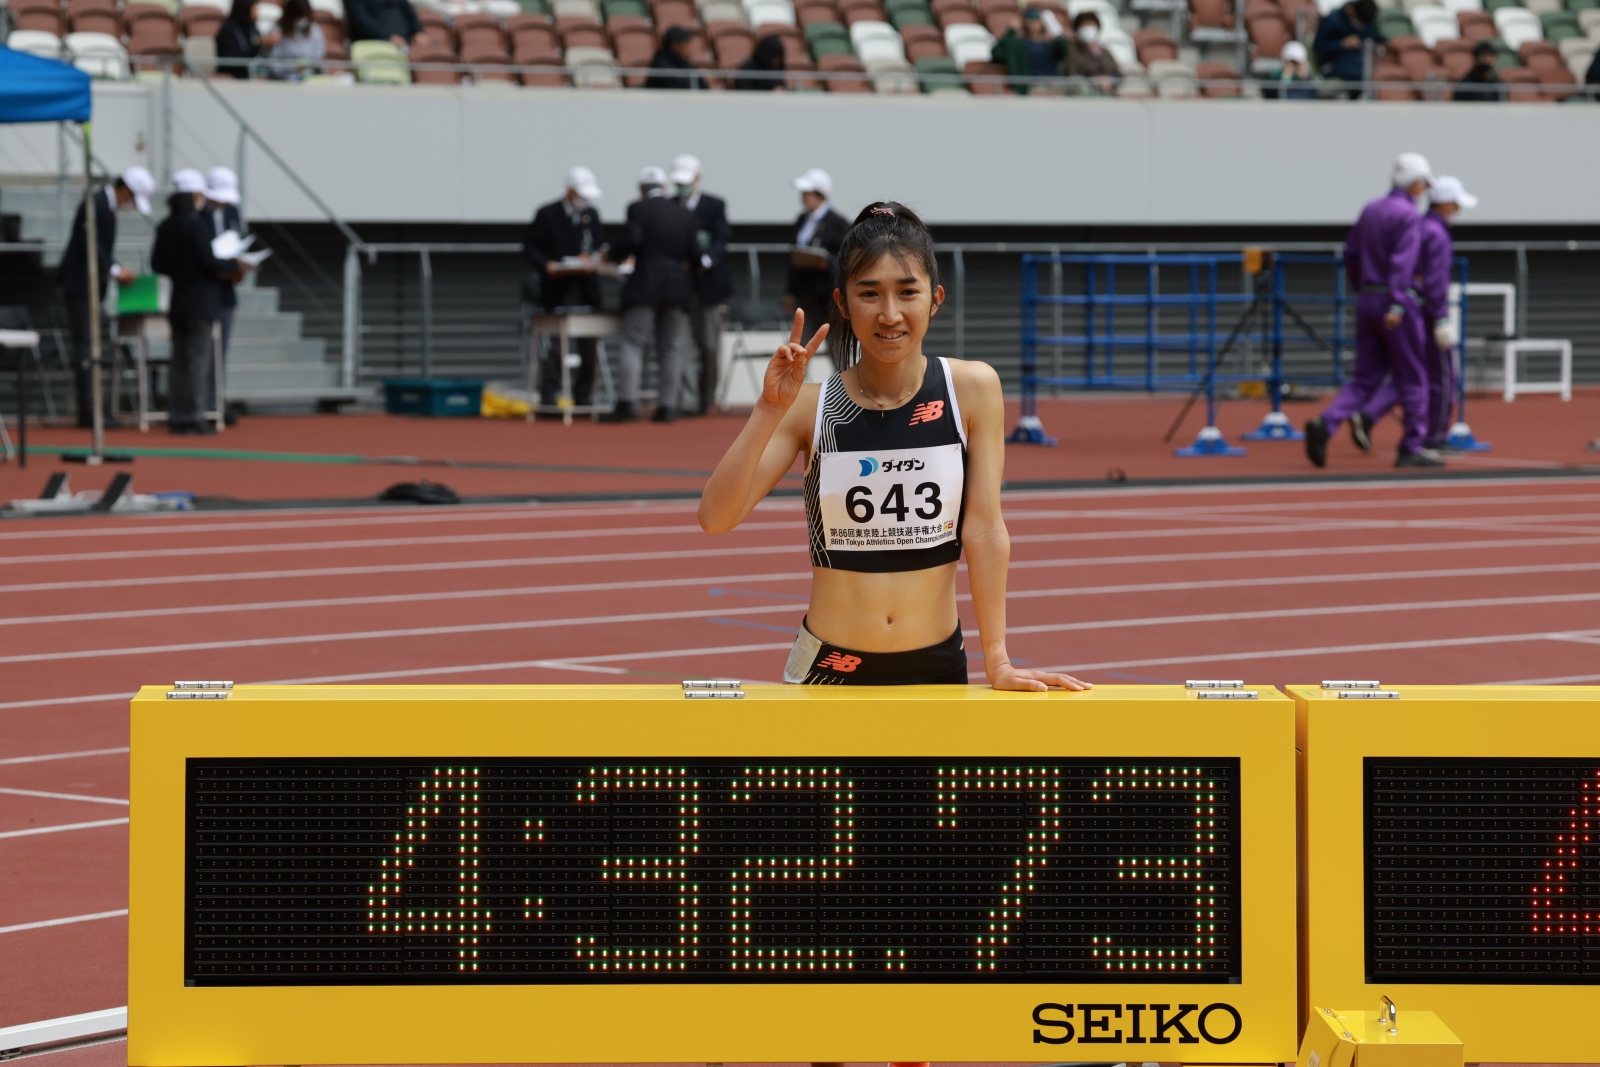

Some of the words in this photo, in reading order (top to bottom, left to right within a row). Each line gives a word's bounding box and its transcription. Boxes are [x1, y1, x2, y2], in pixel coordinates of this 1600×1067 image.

[881, 457, 925, 473] ダイダン
[845, 481, 943, 524] 643
[829, 523, 943, 539] 第86回東京陸上競技選手権大会
[830, 537, 845, 546] 86th
[846, 538, 865, 547] Tokyo
[866, 537, 896, 546] Athletics
[896, 537, 914, 546] Open
[366, 766, 1216, 972] 4:32.73
[1031, 1002, 1243, 1045] SEIKO
